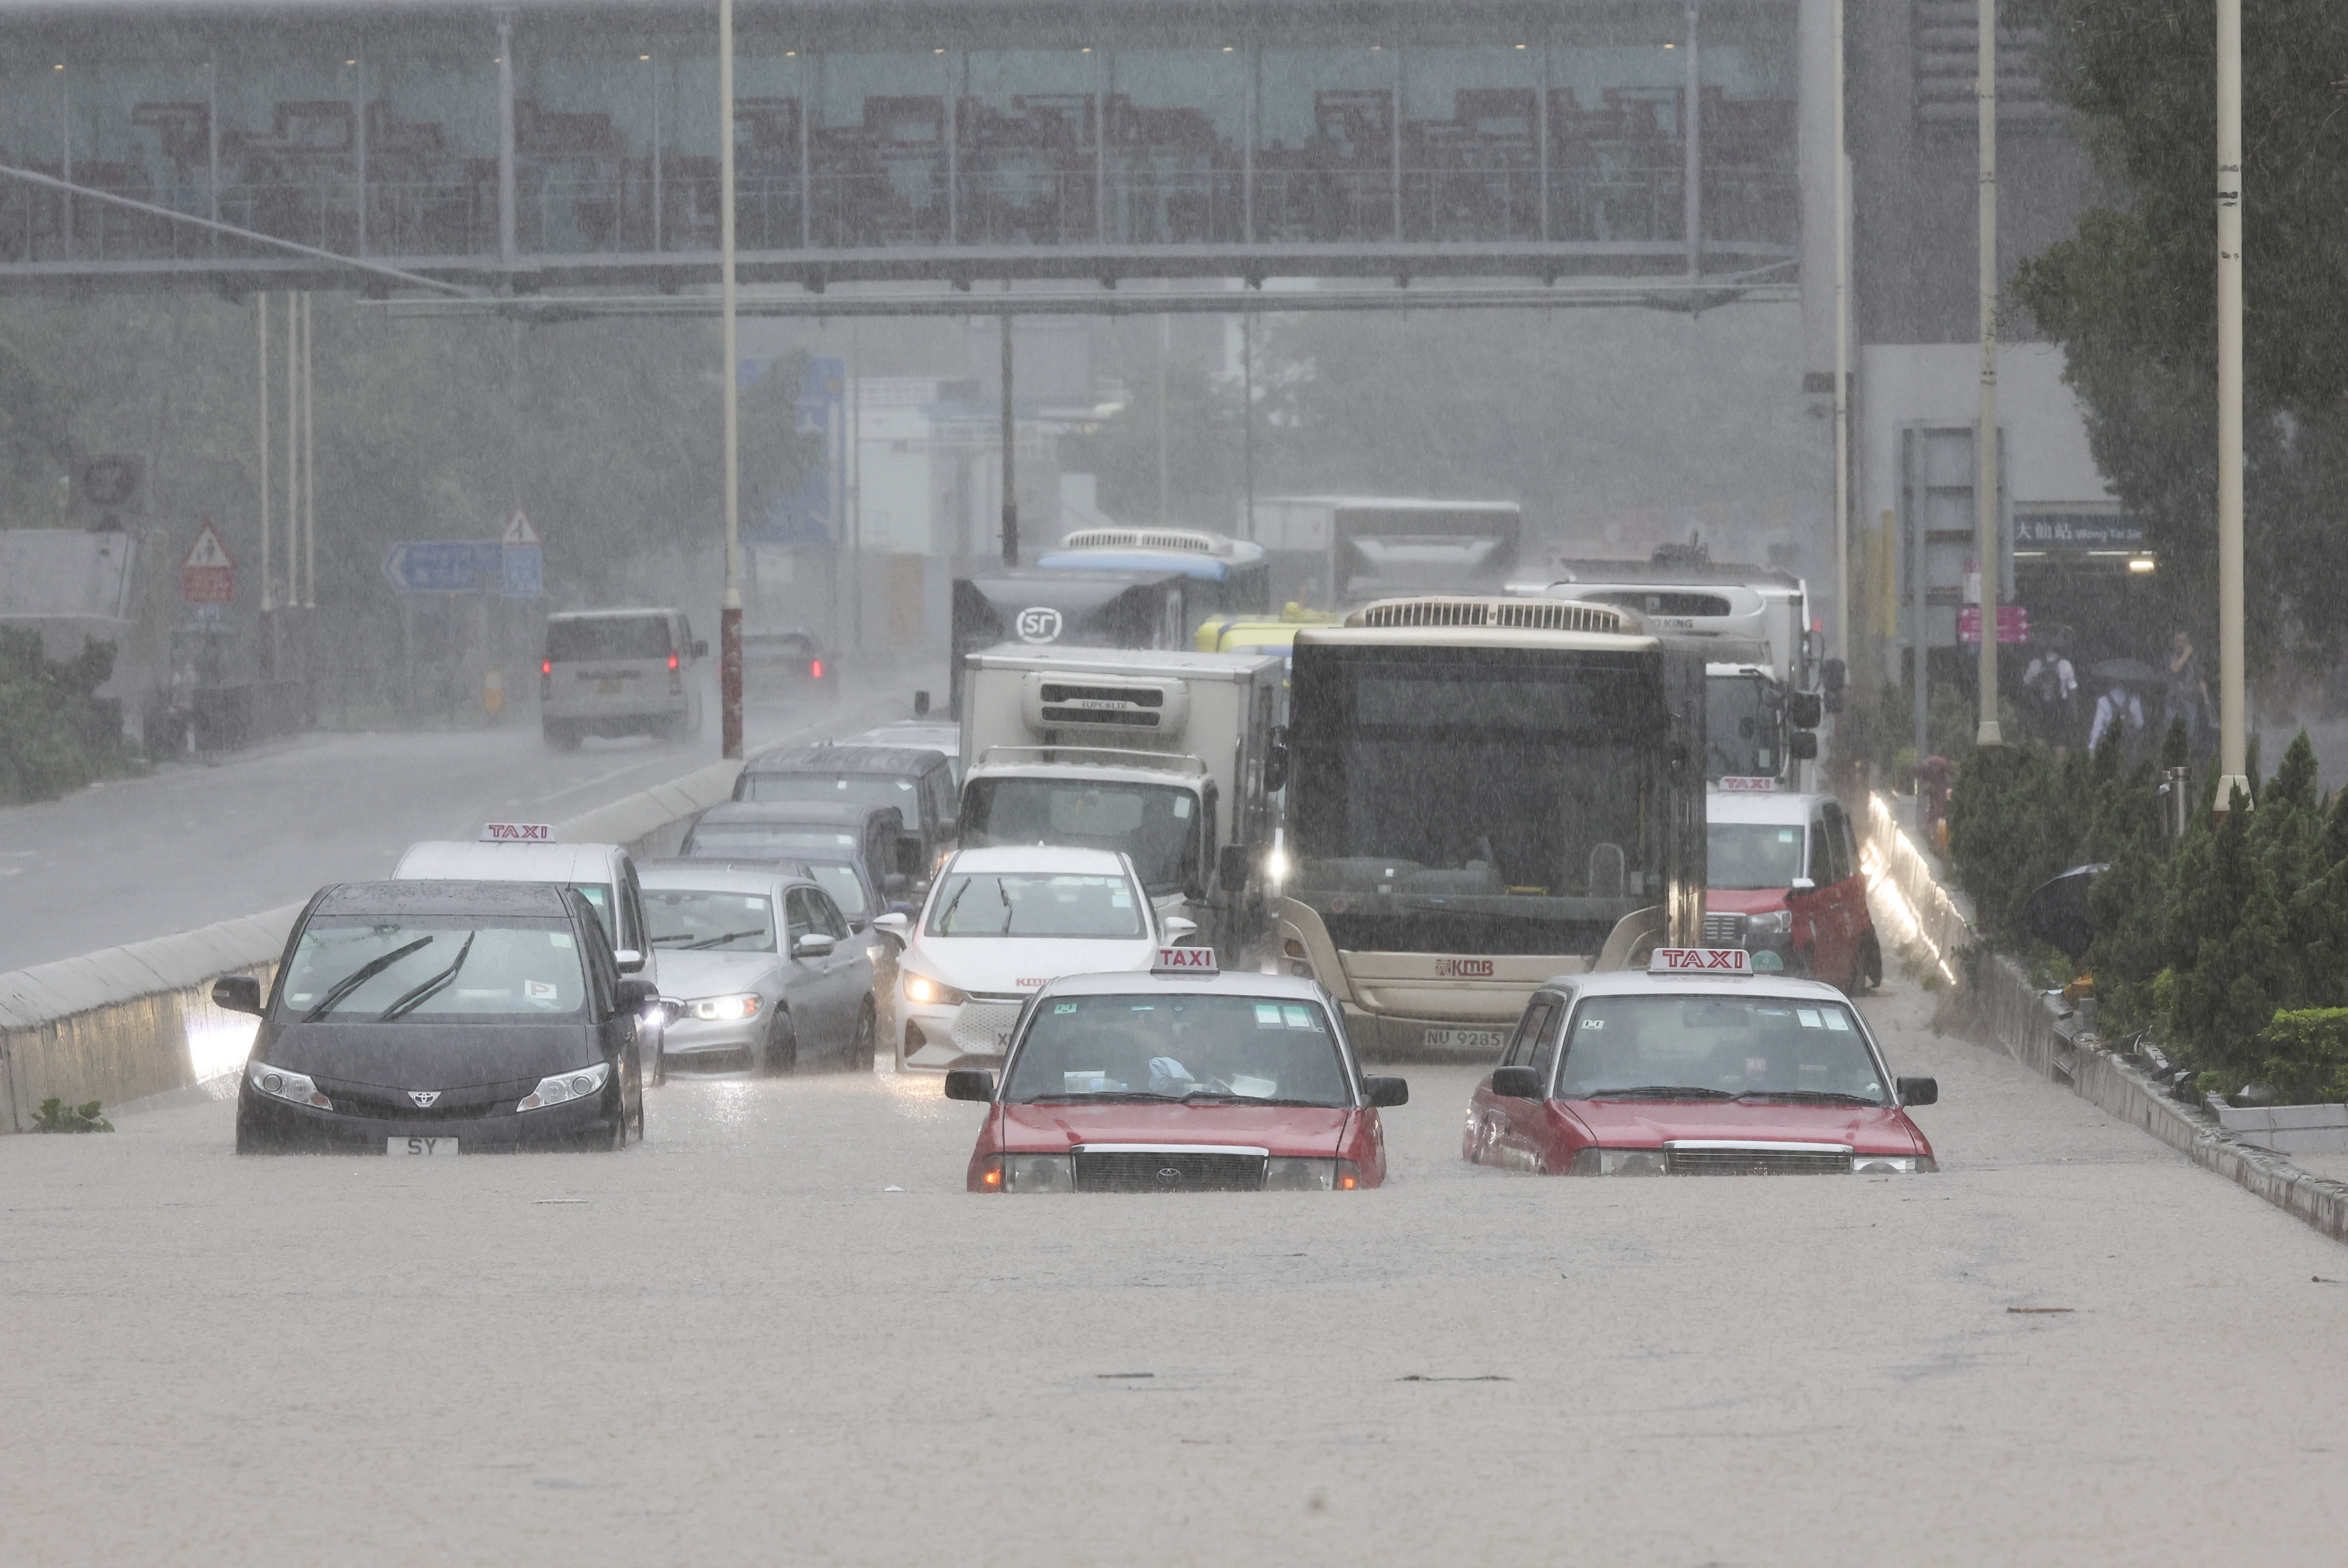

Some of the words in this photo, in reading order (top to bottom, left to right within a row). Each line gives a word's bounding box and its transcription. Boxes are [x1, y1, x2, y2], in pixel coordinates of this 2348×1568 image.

[1664, 619, 1693, 628] KING
[1725, 778, 1770, 789] TAXI
[489, 824, 547, 839] TAXI
[1161, 950, 1210, 966] TAXI
[1662, 949, 1743, 969] TAXI
[1452, 960, 1494, 976] KMB
[530, 982, 550, 996] P
[1428, 1031, 1450, 1044] NU
[1458, 1033, 1501, 1046] 9285
[408, 1138, 437, 1155] SY
